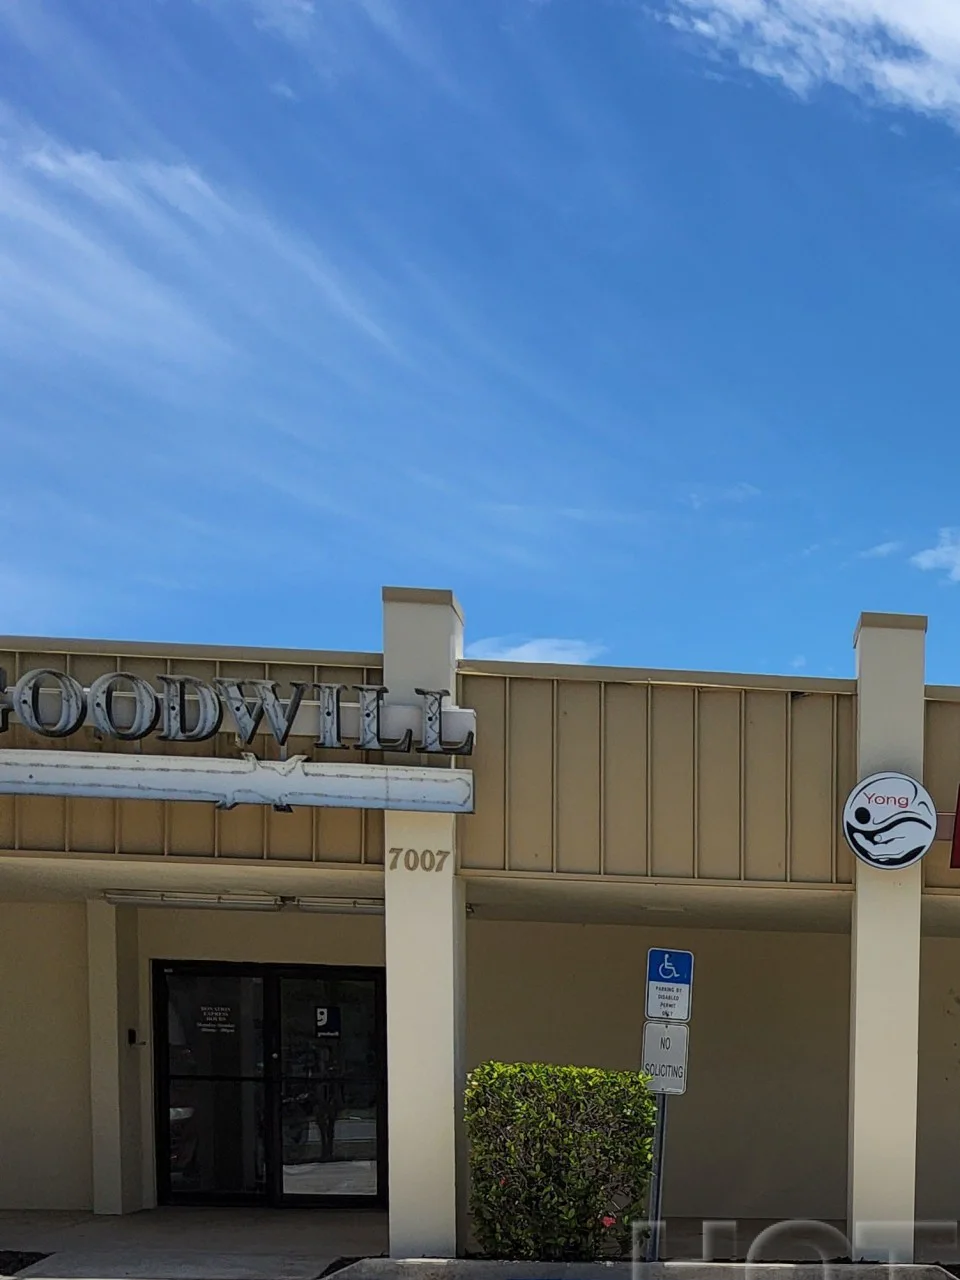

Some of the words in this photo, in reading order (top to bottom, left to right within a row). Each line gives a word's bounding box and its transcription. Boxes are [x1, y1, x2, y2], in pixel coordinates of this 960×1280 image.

[0, 667, 475, 756] OODWILL
[863, 792, 909, 808] Yong
[388, 847, 451, 873] 7007
[660, 1037, 671, 1050] NO
[644, 1063, 684, 1078] SOLICITING
